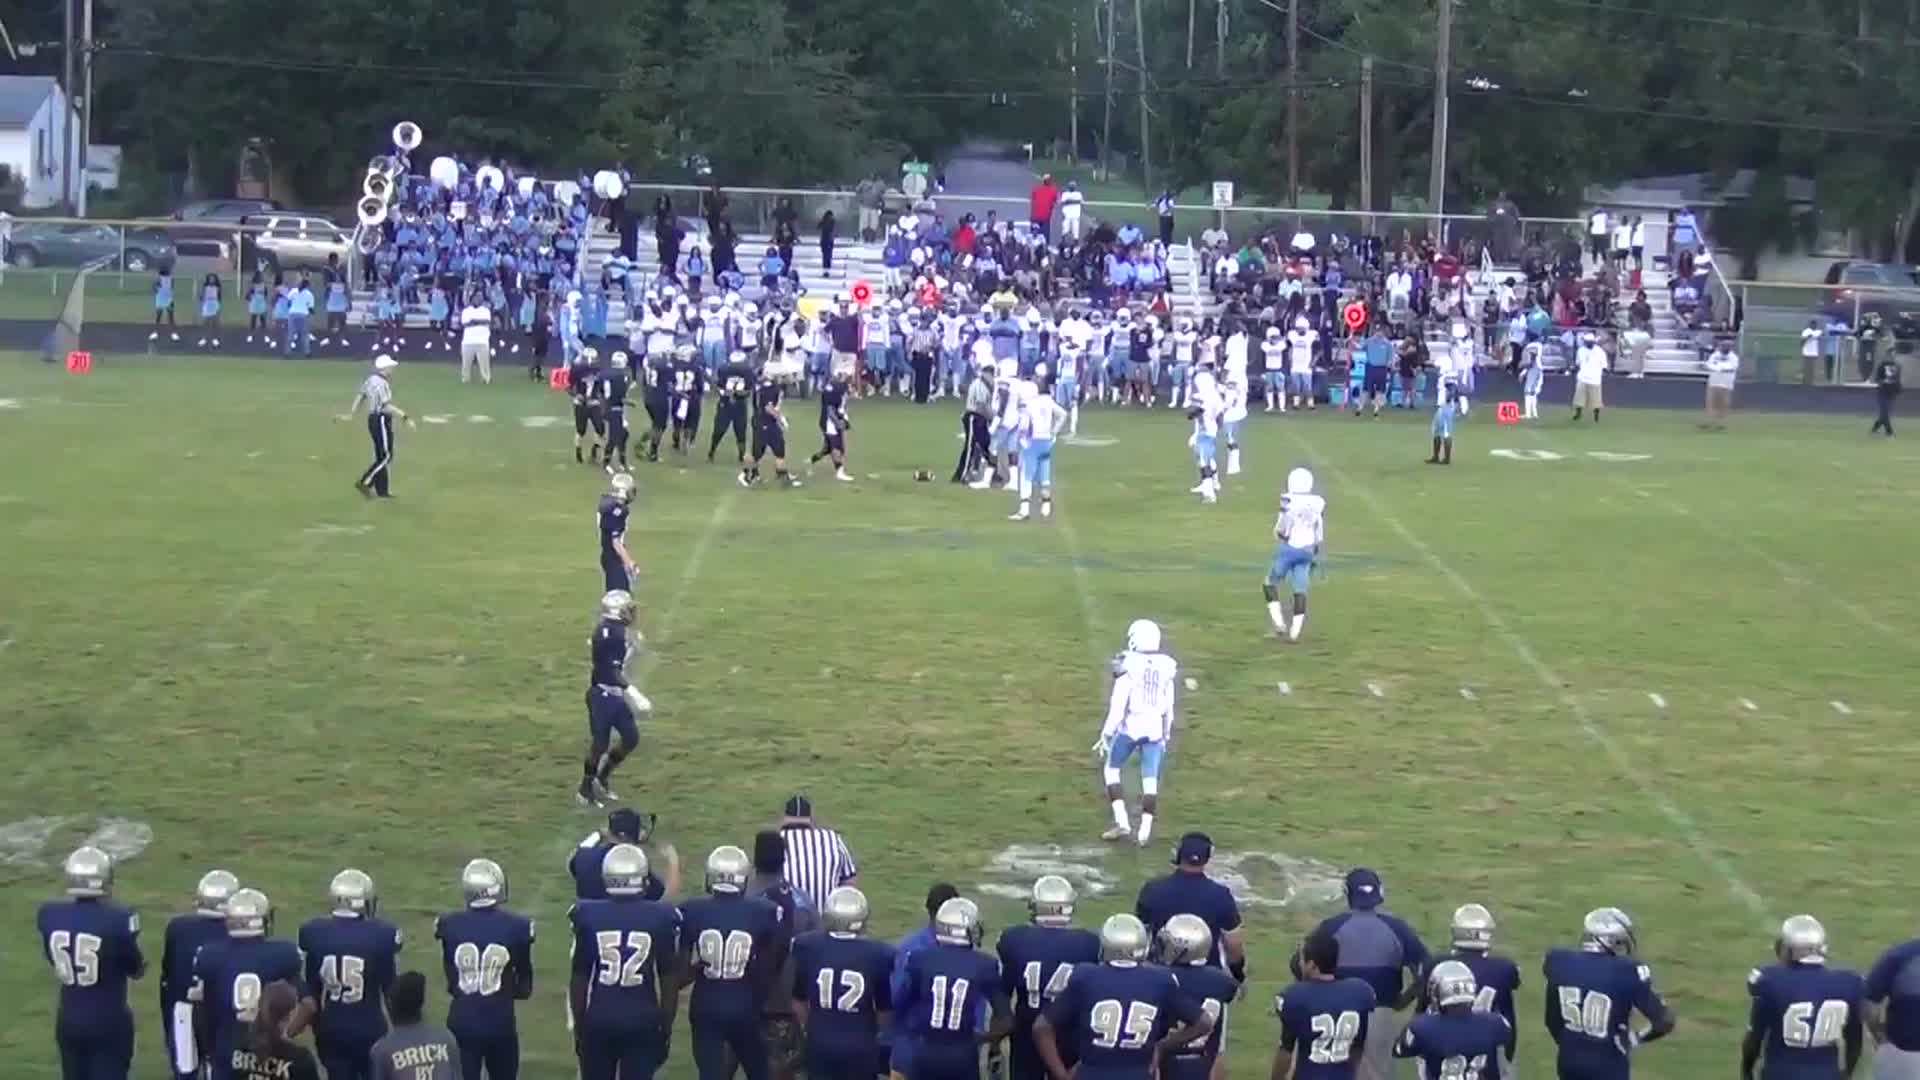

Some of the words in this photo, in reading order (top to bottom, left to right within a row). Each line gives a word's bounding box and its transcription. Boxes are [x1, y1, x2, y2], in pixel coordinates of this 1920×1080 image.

[1500, 405, 1516, 418] 40
[49, 930, 102, 986] 65
[595, 930, 652, 986] 52
[698, 929, 753, 979] 90
[816, 967, 865, 1012] 12
[930, 975, 970, 1030] 11
[1556, 986, 1612, 1038] 50
[1089, 999, 1158, 1049] 95
[391, 1044, 449, 1070] BRICK
[414, 1063, 434, 1080] BY
